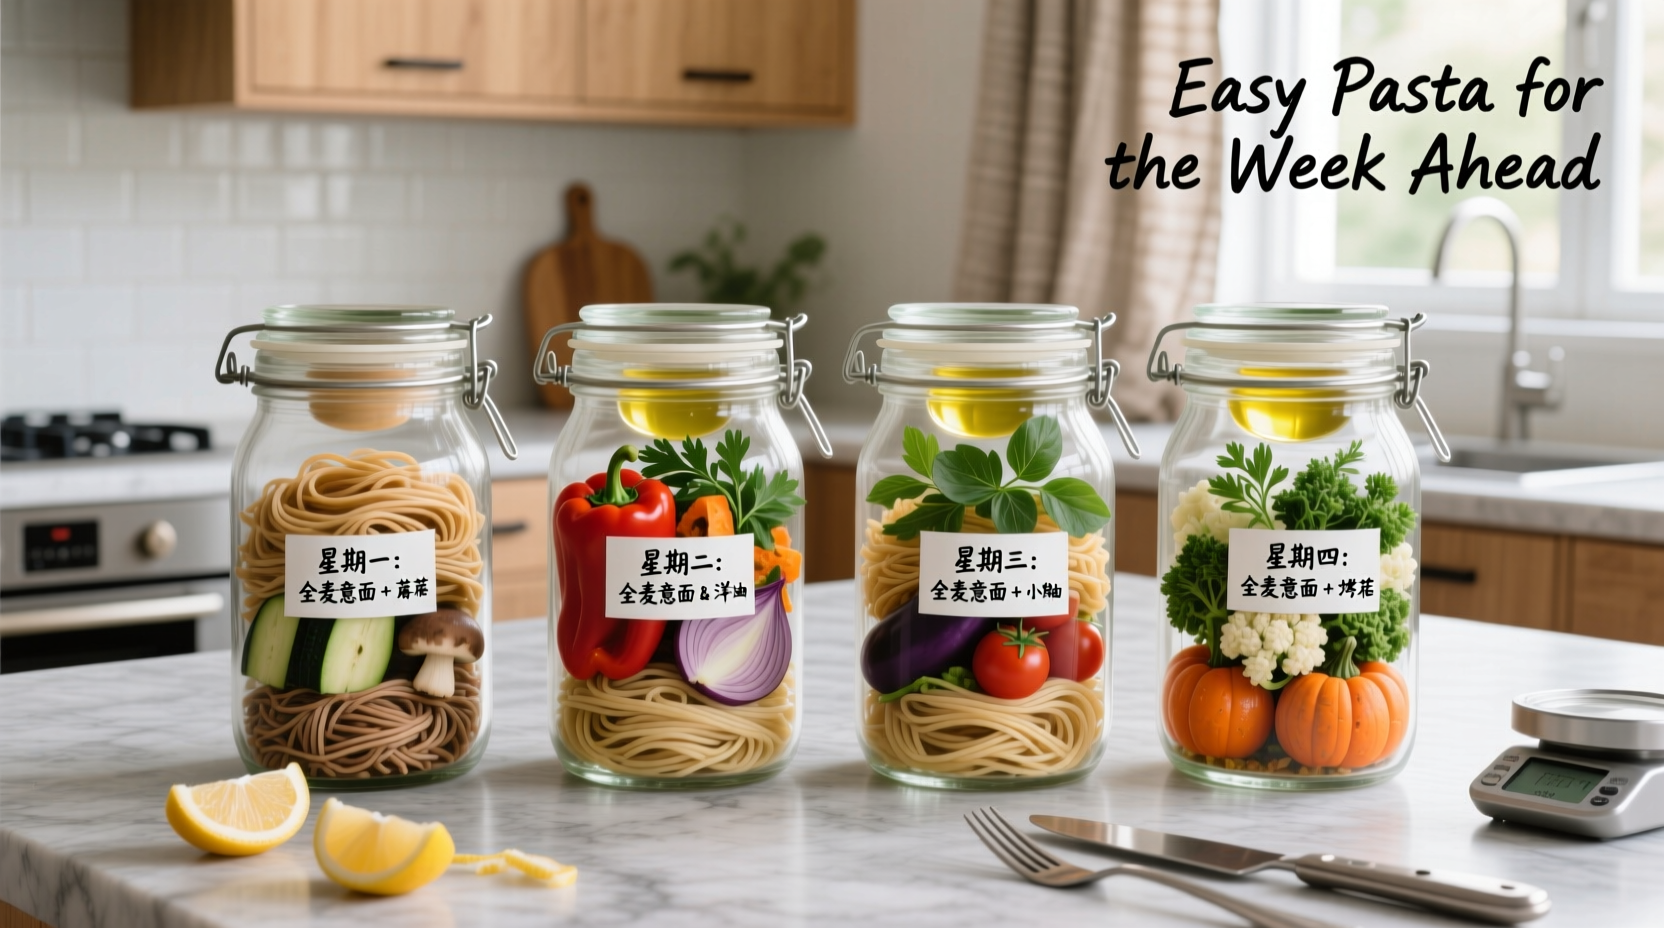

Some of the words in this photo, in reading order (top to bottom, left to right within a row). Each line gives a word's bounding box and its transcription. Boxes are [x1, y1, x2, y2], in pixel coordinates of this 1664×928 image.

[318, 546, 400, 575] 星期一:
[640, 548, 722, 577] 星期二:
[954, 545, 1037, 574] 星期三:
[1265, 542, 1348, 571] 星期四:
